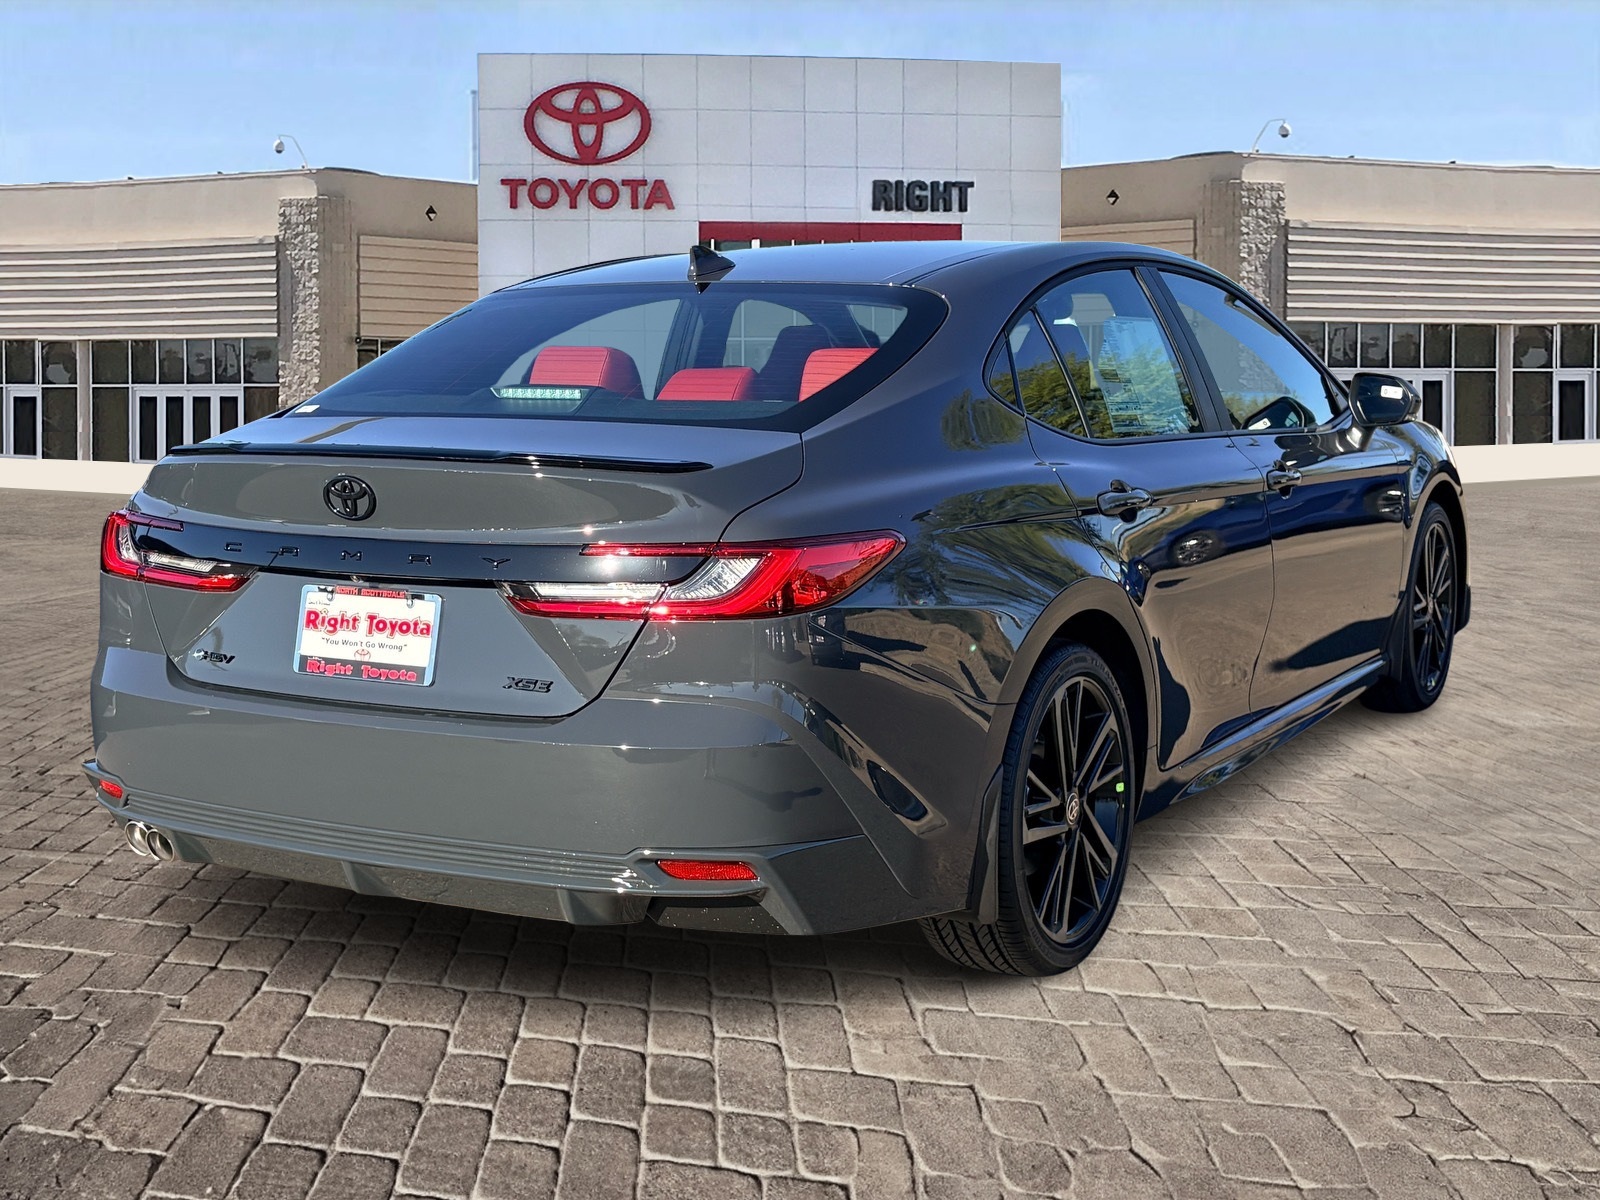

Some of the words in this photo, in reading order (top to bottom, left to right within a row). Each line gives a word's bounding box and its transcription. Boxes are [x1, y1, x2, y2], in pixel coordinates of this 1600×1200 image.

[500, 178, 675, 210] TOYOTA
[872, 180, 975, 212] RIGHT
[305, 608, 360, 635] Right
[365, 613, 432, 638] Toyota
[307, 659, 353, 676] Right
[361, 664, 417, 681] Toyota
